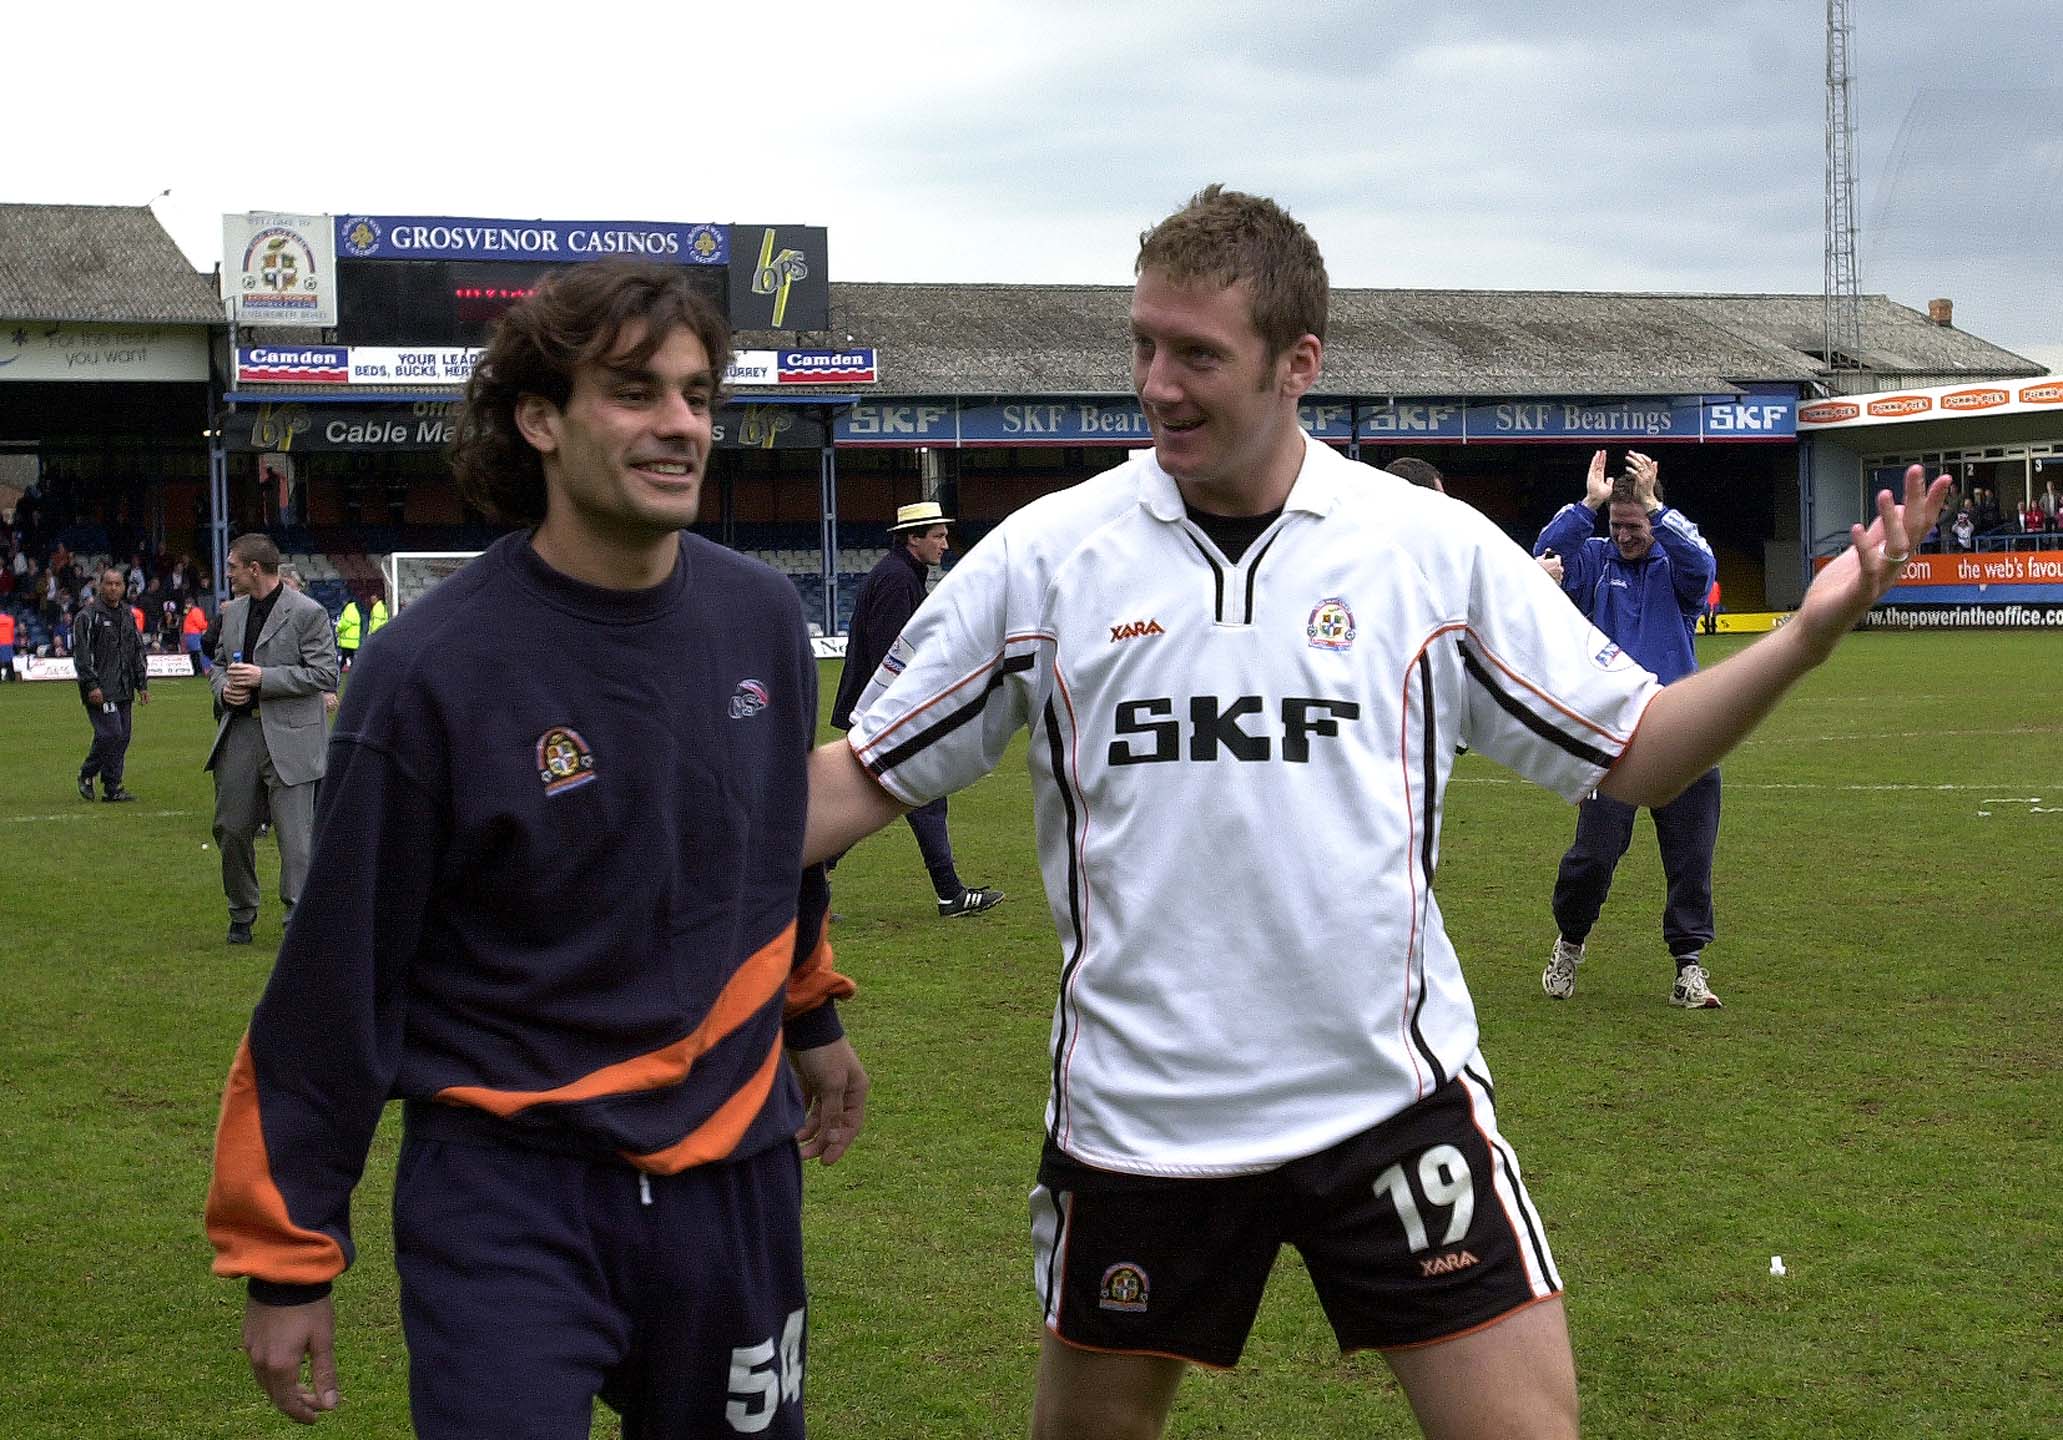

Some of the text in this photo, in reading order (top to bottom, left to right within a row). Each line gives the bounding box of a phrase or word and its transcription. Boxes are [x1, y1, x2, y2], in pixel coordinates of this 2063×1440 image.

[390, 226, 560, 251] GROSVENOR
[567, 230, 679, 254] CASINOS
[66, 348, 146, 368] you want
[249, 349, 338, 365] Camden
[399, 353, 478, 366] YOUR LEAD
[786, 353, 864, 366] Camden
[848, 406, 947, 433] SKF
[1002, 404, 1066, 432] SKF
[1369, 405, 1455, 431] SKF
[1495, 404, 1673, 436] SKF Bearings
[1709, 405, 1788, 431] SKF
[325, 420, 412, 443] Cable
[1967, 463, 1975, 477] 2
[2034, 458, 2043, 473] 3
[1901, 556, 2063, 580] com the web's favou
[1110, 618, 1166, 643] XARA
[1108, 695, 1361, 767] SKF
[1372, 1143, 1475, 1254] 19
[1420, 1250, 1481, 1277] XARA
[725, 1306, 805, 1434] 54
